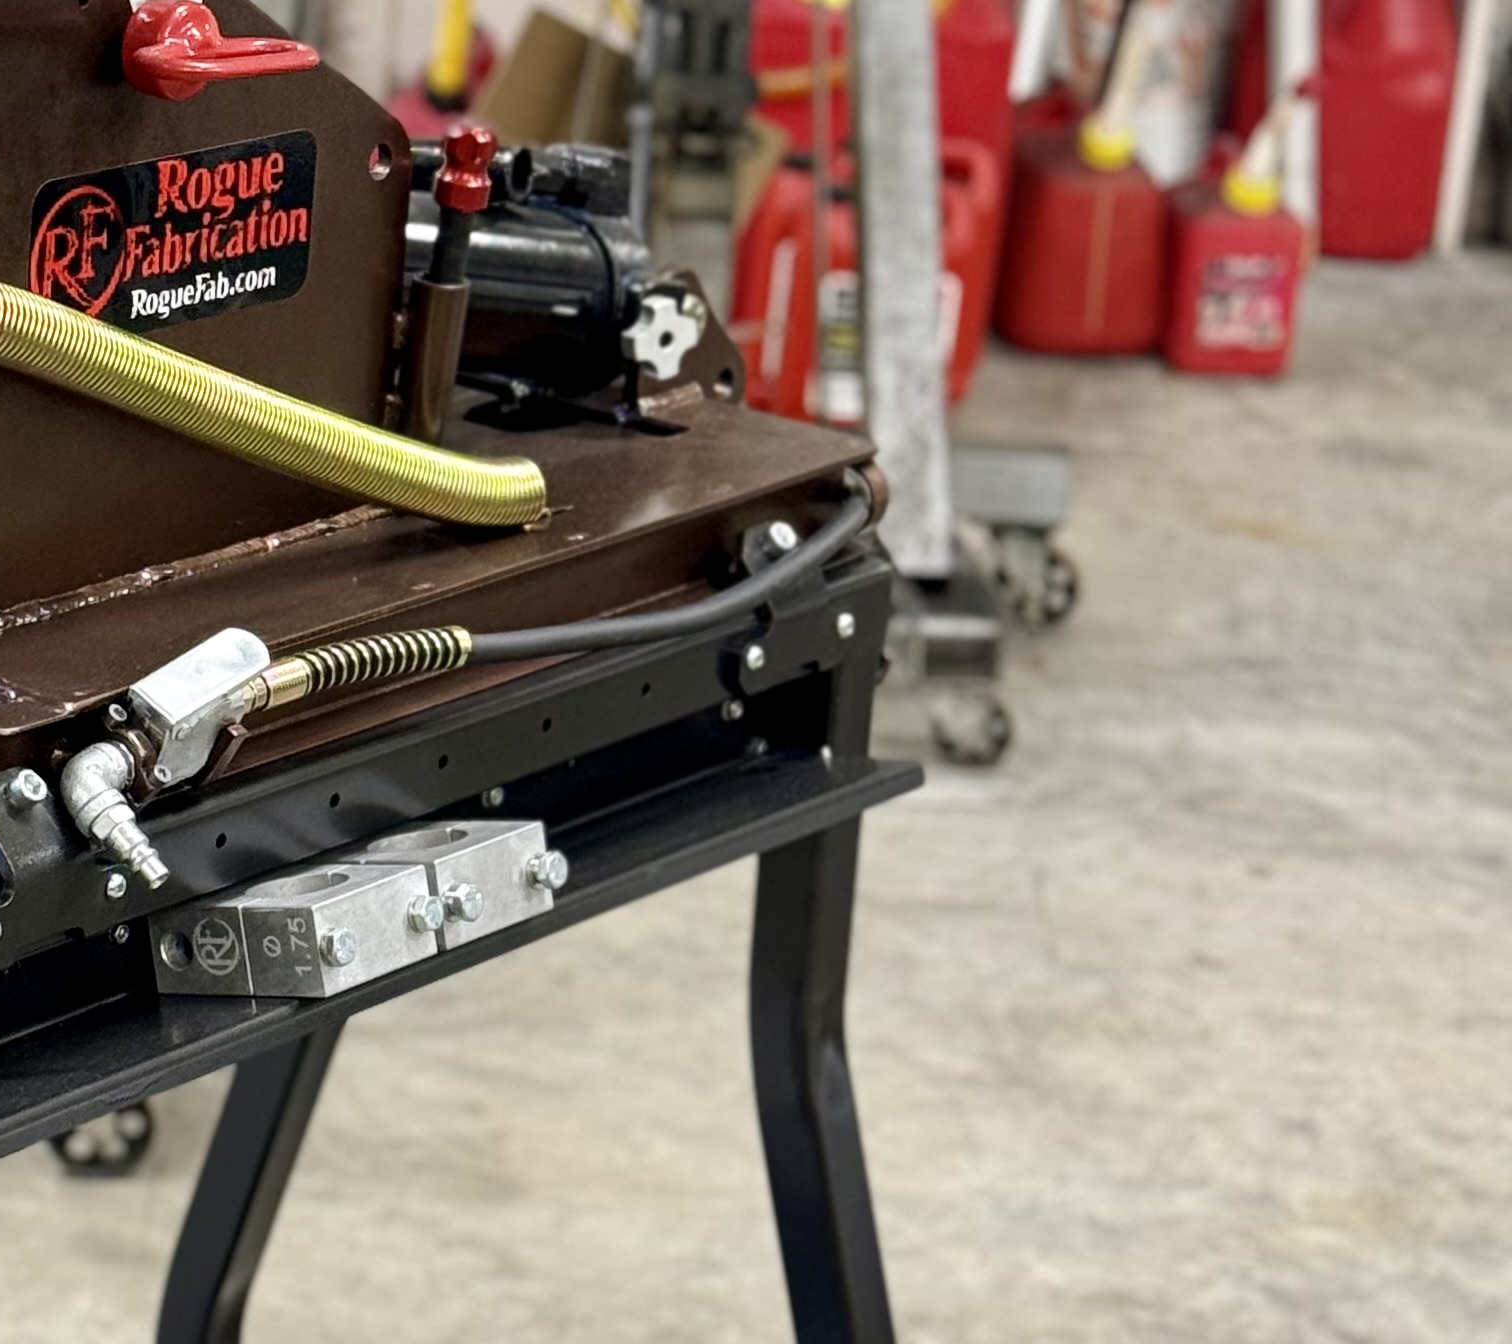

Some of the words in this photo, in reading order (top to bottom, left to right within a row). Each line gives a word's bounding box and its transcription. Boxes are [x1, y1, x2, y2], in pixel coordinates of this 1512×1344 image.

[154, 152, 285, 218] Rogue
[123, 199, 309, 283] Fabrication
[130, 266, 276, 320] RogueFab.com
[287, 917, 313, 977] 1.75
